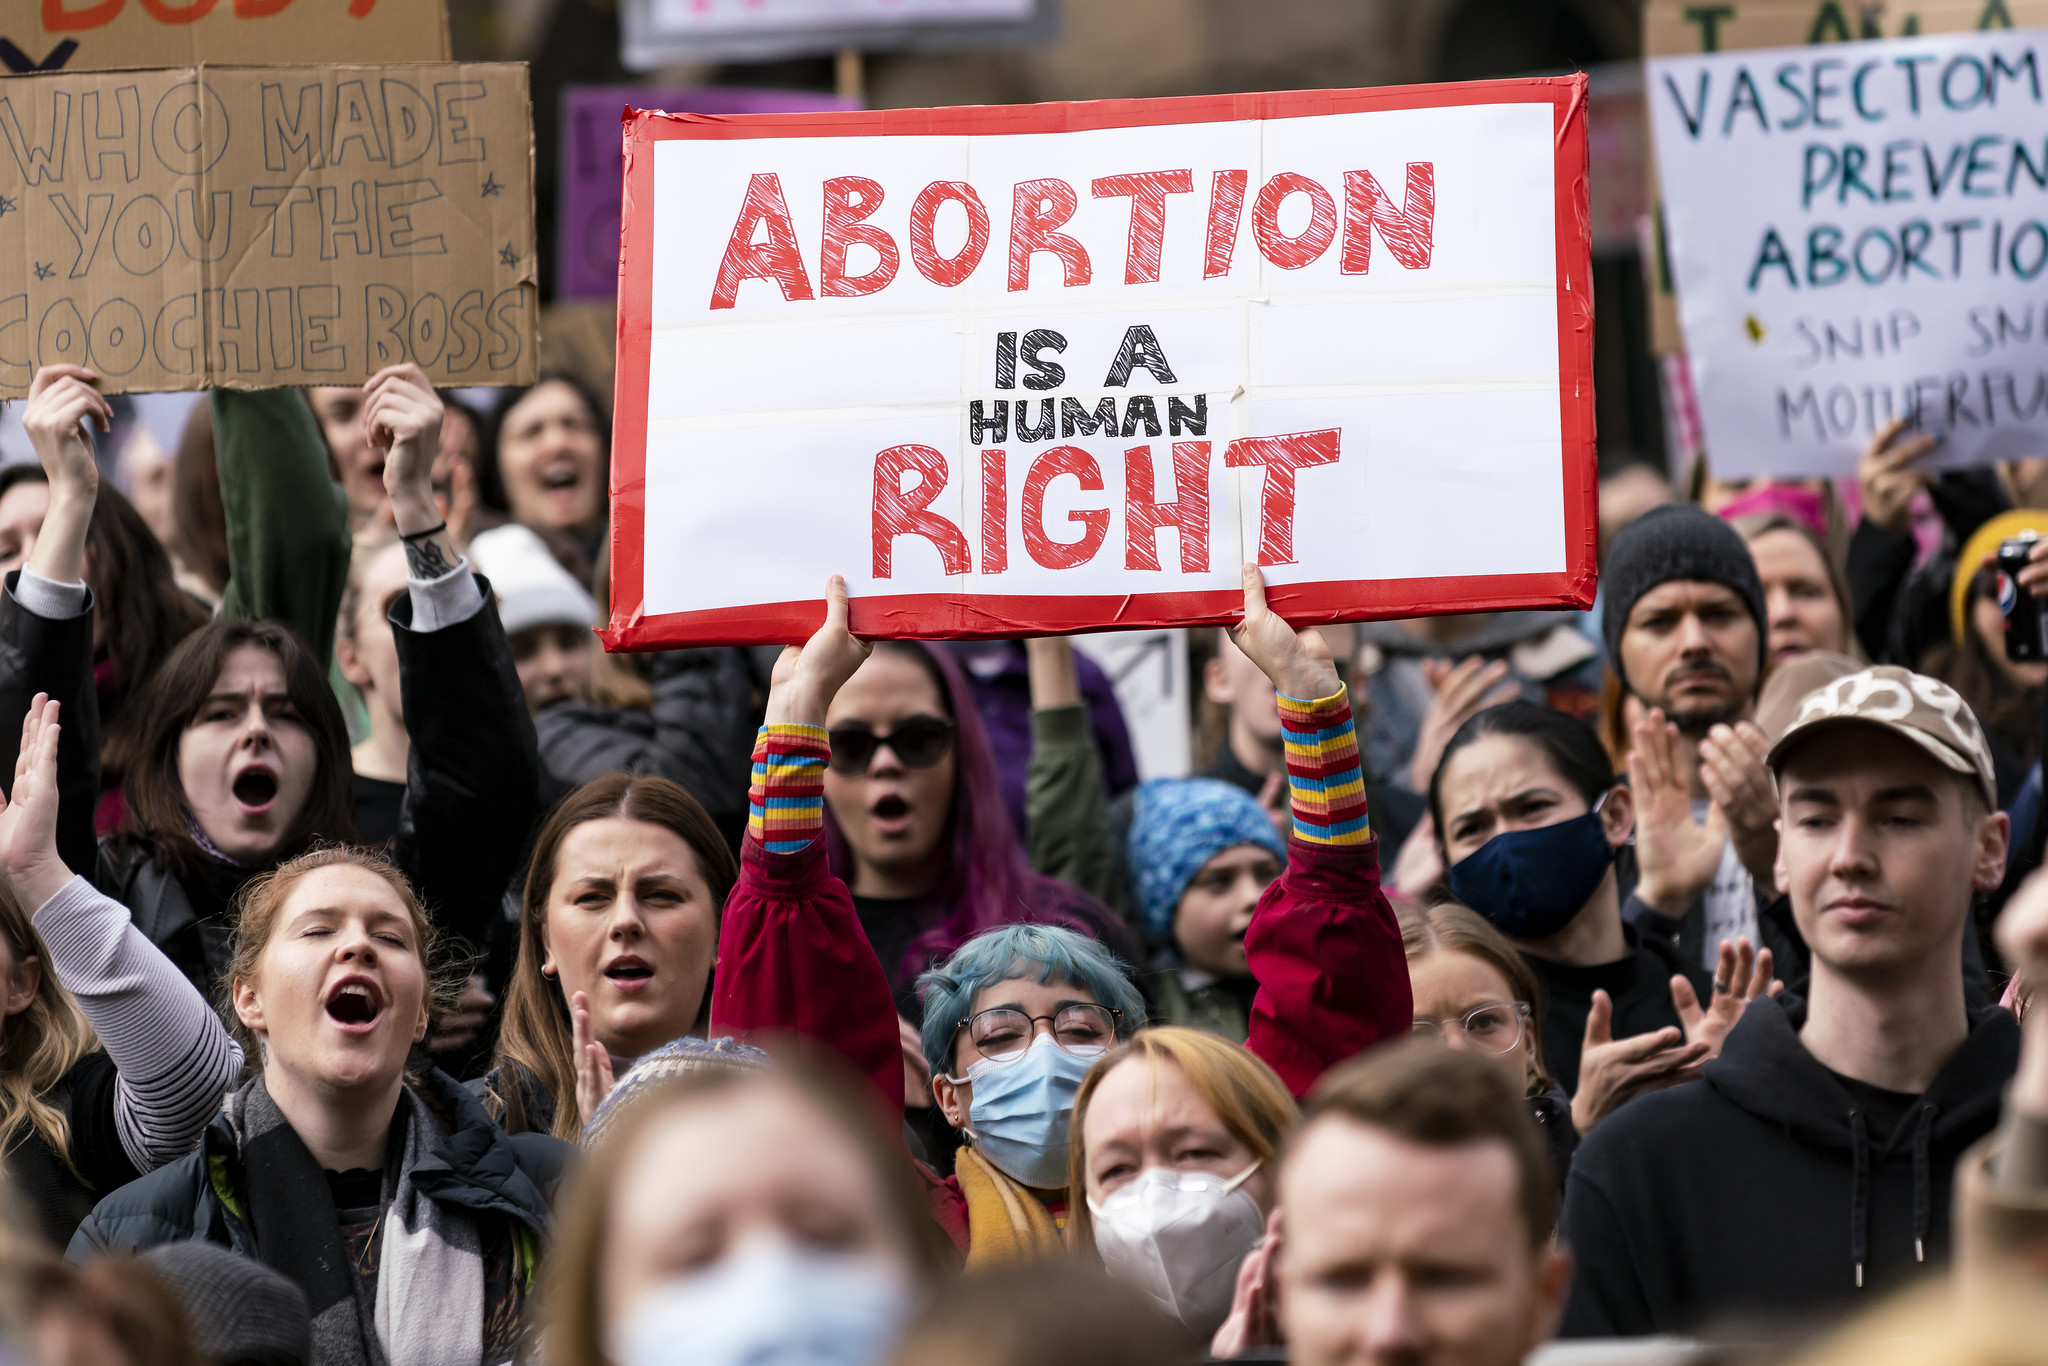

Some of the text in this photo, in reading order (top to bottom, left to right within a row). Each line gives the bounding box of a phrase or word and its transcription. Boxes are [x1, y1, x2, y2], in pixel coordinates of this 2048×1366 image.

[0, 79, 486, 187] WHO MADE
[1662, 45, 2044, 140] VASECTOM
[1800, 132, 2048, 212] PREVEN
[49, 179, 447, 279] YOU THE
[710, 162, 1435, 310] ABORTION
[1746, 215, 2048, 292] ABORTIO
[0, 283, 524, 389] COOCHIE BOSS
[995, 324, 1177, 390] IS A
[1793, 307, 1922, 371] SNIP
[970, 393, 1208, 445] HUMAN
[872, 427, 1342, 579] RIGHT
